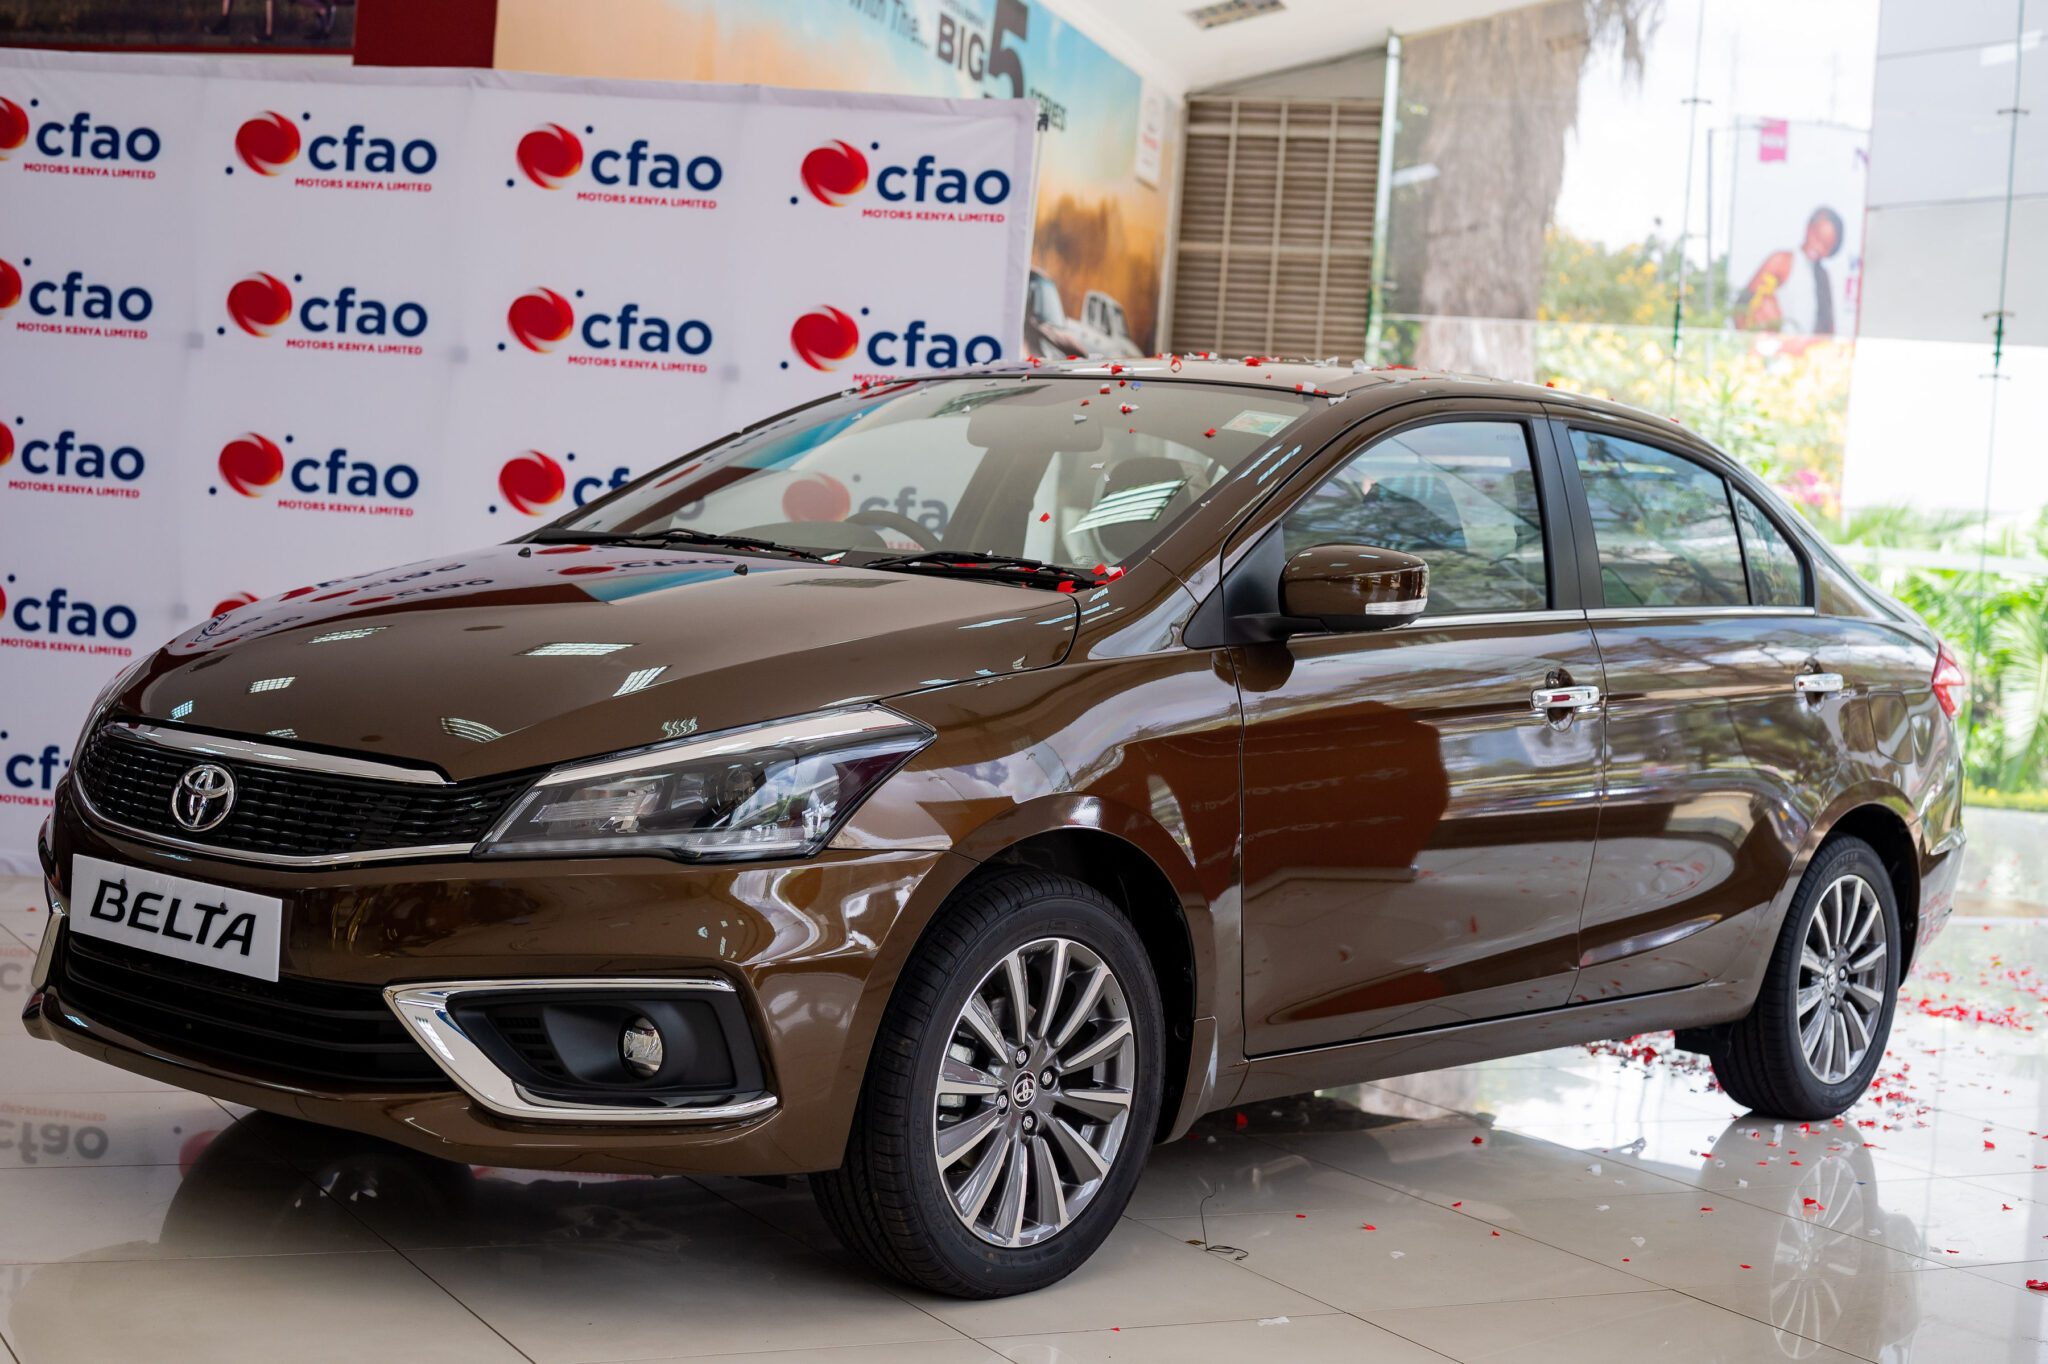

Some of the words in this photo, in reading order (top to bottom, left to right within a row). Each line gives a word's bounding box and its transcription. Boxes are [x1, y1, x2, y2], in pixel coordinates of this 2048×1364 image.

[938, 11, 985, 82] BIG
[984, 0, 1029, 99] 5
[36, 112, 160, 162] cfao
[308, 125, 437, 174] cfao
[24, 163, 70, 174] MOTORS
[72, 166, 109, 177] KENYA
[112, 168, 156, 180] LIMITED
[294, 178, 343, 189] MOTORS
[346, 180, 384, 190] KENYA
[387, 181, 432, 192] LIMITED
[592, 140, 722, 191] cfao
[877, 156, 1010, 205] cfao
[577, 192, 627, 204] MOTORS
[629, 195, 667, 206] KENYA
[671, 198, 717, 209] LIMITED
[862, 209, 913, 220] MOTORS
[915, 210, 955, 221] KENYA
[958, 213, 1005, 223] LIMITED
[29, 271, 152, 322] cfao
[300, 287, 427, 337] cfao
[17, 322, 62, 333] MOTORS
[65, 325, 101, 336] KENYA
[104, 329, 148, 340] LIMITED
[286, 339, 335, 350] MOTORS
[337, 342, 375, 352] KENYA
[378, 345, 423, 356] LIMITED
[582, 304, 712, 355] cfao
[868, 321, 1002, 368] cfao
[568, 356, 617, 367] MOTORS
[620, 359, 658, 369] KENYA
[661, 362, 707, 373] LIMITED
[21, 430, 144, 481] cfao
[291, 449, 418, 499] cfao
[9, 480, 55, 492] MOTORS
[58, 484, 94, 495] KENYA
[97, 487, 140, 499] LIMITED
[278, 500, 325, 512] MOTORS
[328, 503, 367, 514] KENYA
[369, 506, 414, 518] LIMITED
[13, 588, 137, 639] cfao
[1, 638, 47, 650] MOTORS
[49, 641, 86, 653] KENYA
[88, 645, 132, 657] LIMITED
[6, 745, 70, 790] cf
[0, 794, 40, 806] OTORS
[90, 879, 257, 956] BELTA
